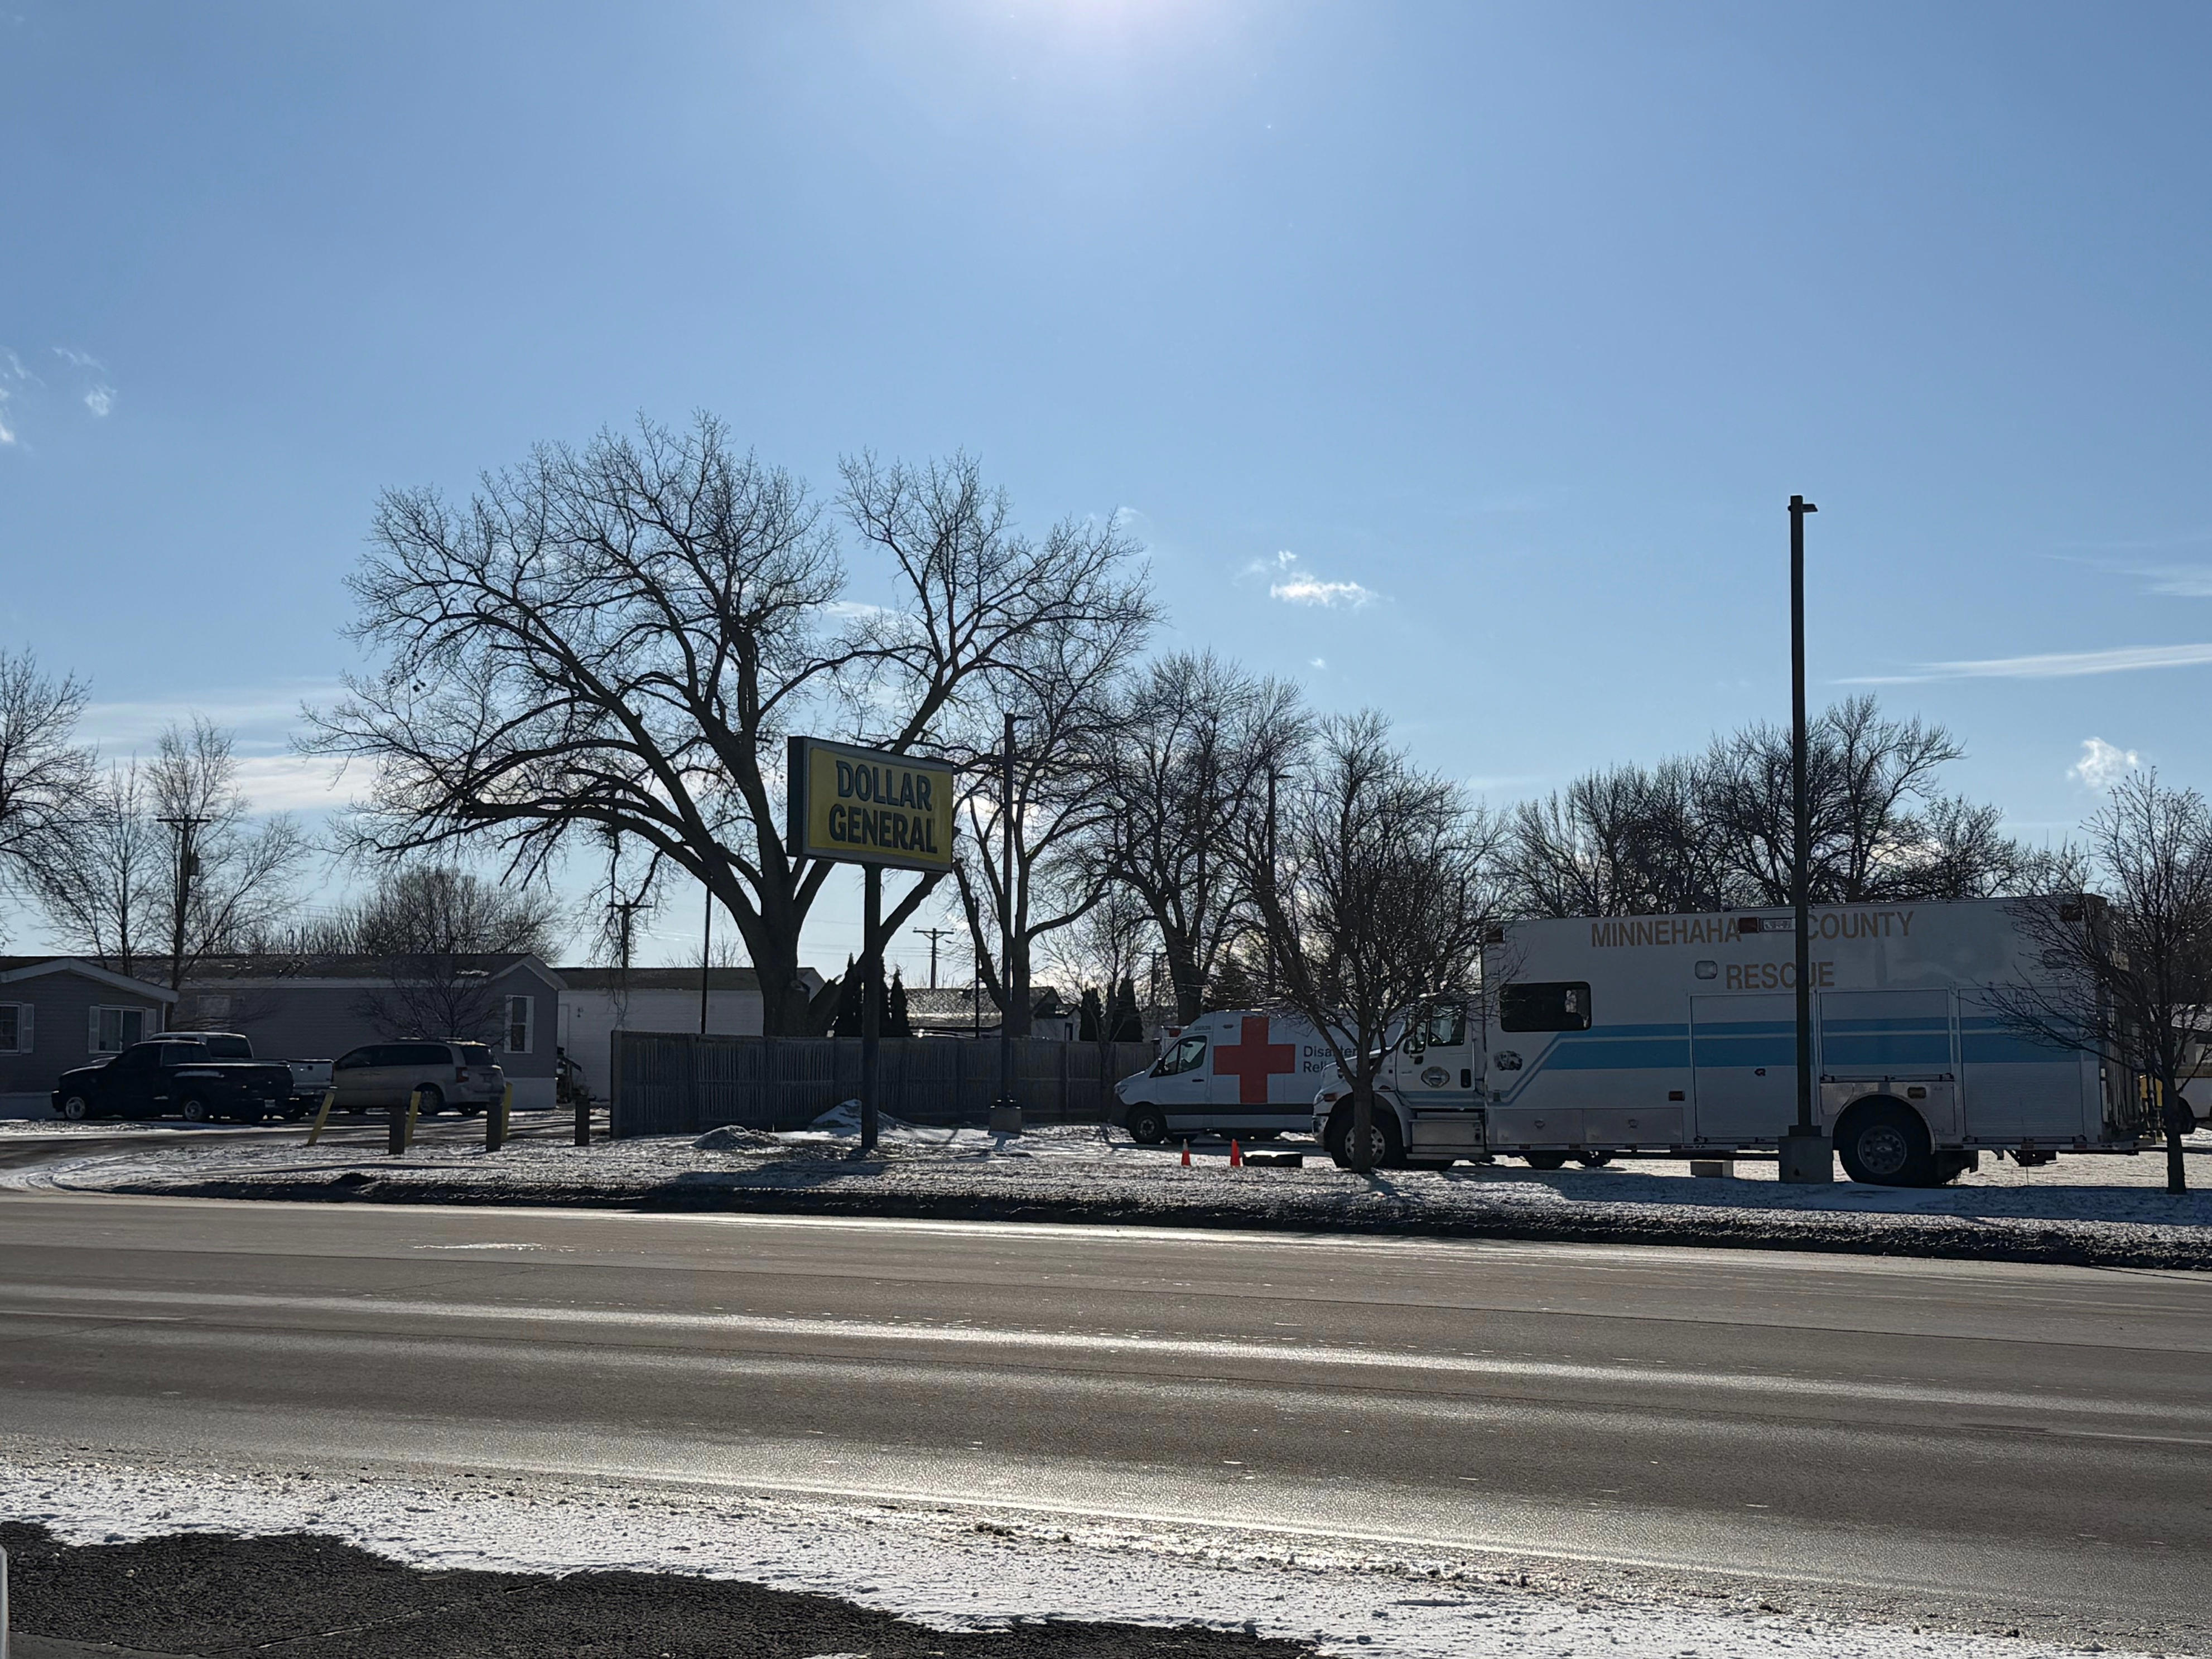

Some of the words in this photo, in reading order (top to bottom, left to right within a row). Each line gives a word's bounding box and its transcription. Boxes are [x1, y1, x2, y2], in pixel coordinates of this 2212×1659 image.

[836, 760, 932, 812] DOLLAR
[829, 804, 937, 853] GENERAL
[1592, 918, 1742, 947] MINNEHAHA
[1808, 911, 1914, 939] COUNTY
[1304, 1045, 1357, 1057] Disater
